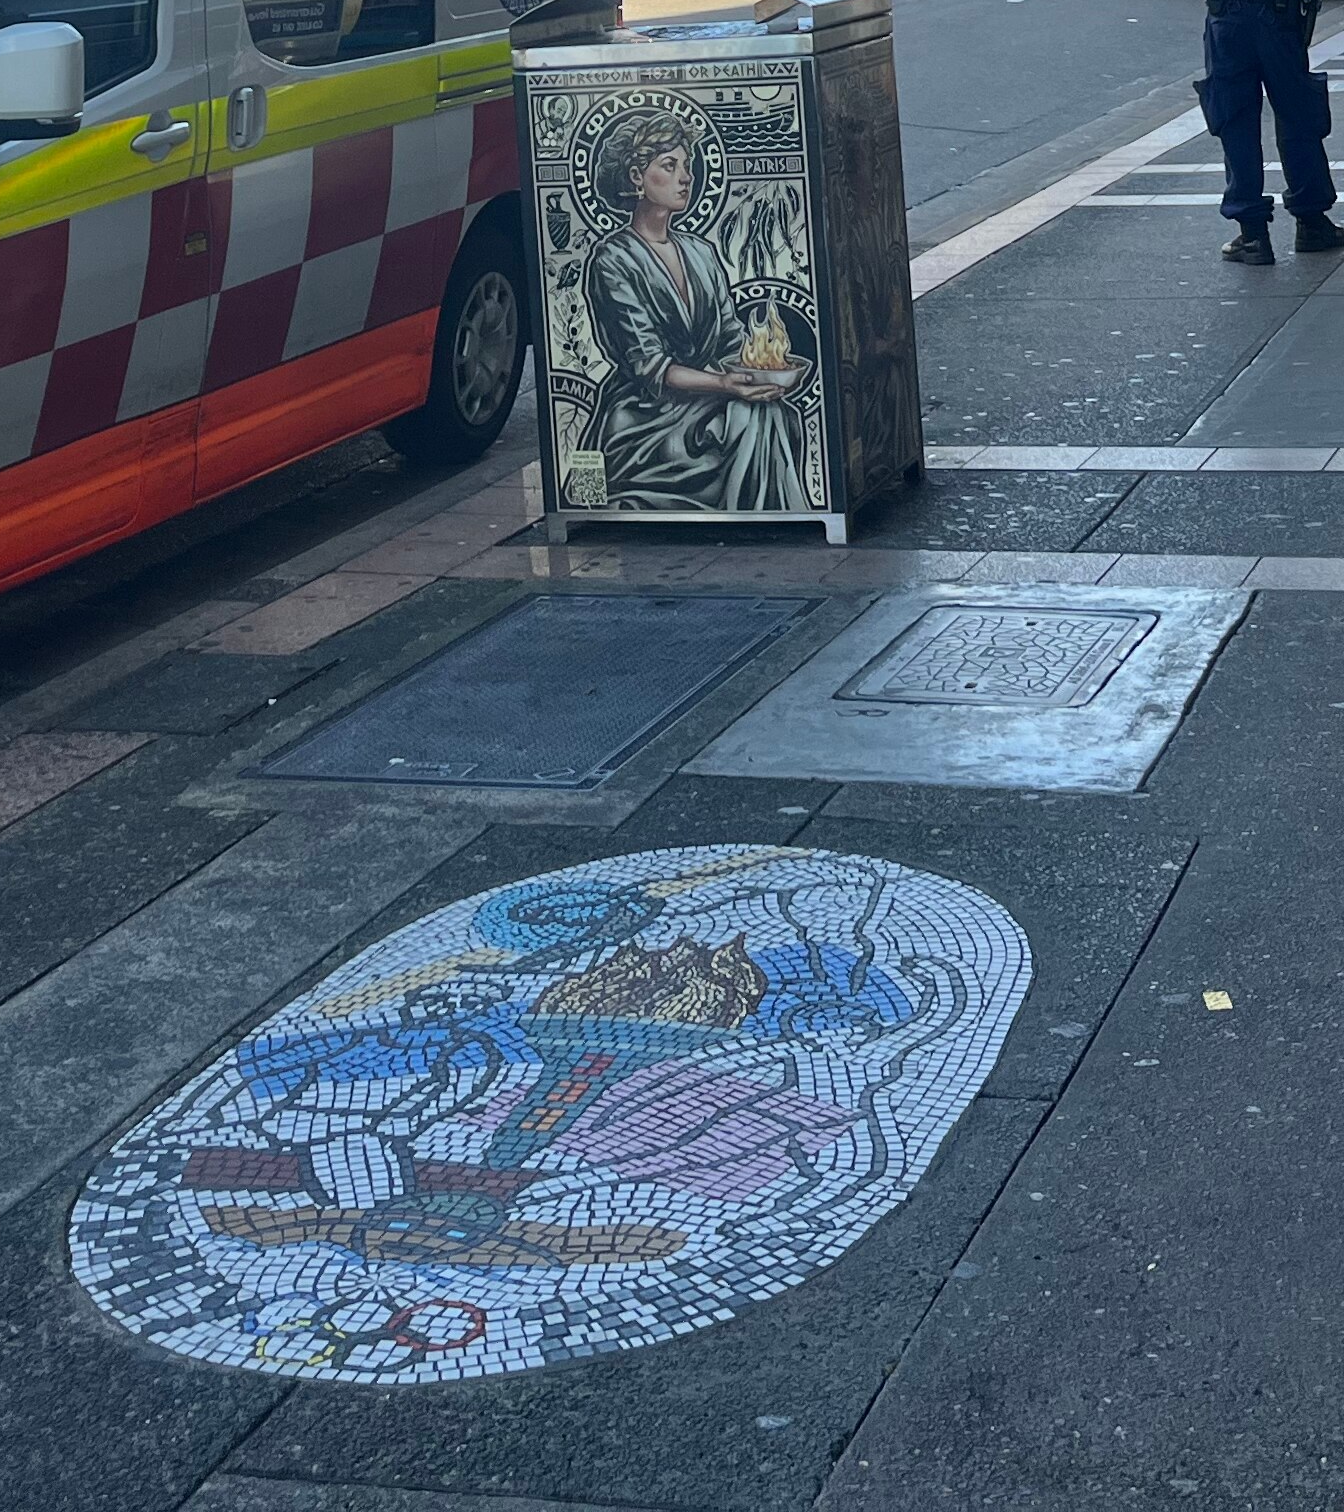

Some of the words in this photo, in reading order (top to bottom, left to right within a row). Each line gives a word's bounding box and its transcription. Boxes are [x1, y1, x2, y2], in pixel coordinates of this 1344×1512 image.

[568, 66, 633, 85] FREEDOM
[688, 65, 710, 80] OR
[713, 63, 756, 78] DEATH
[744, 157, 785, 174] PATRIS
[552, 375, 595, 407] LAMIA
[807, 419, 819, 446] OX
[810, 450, 823, 502] KING
